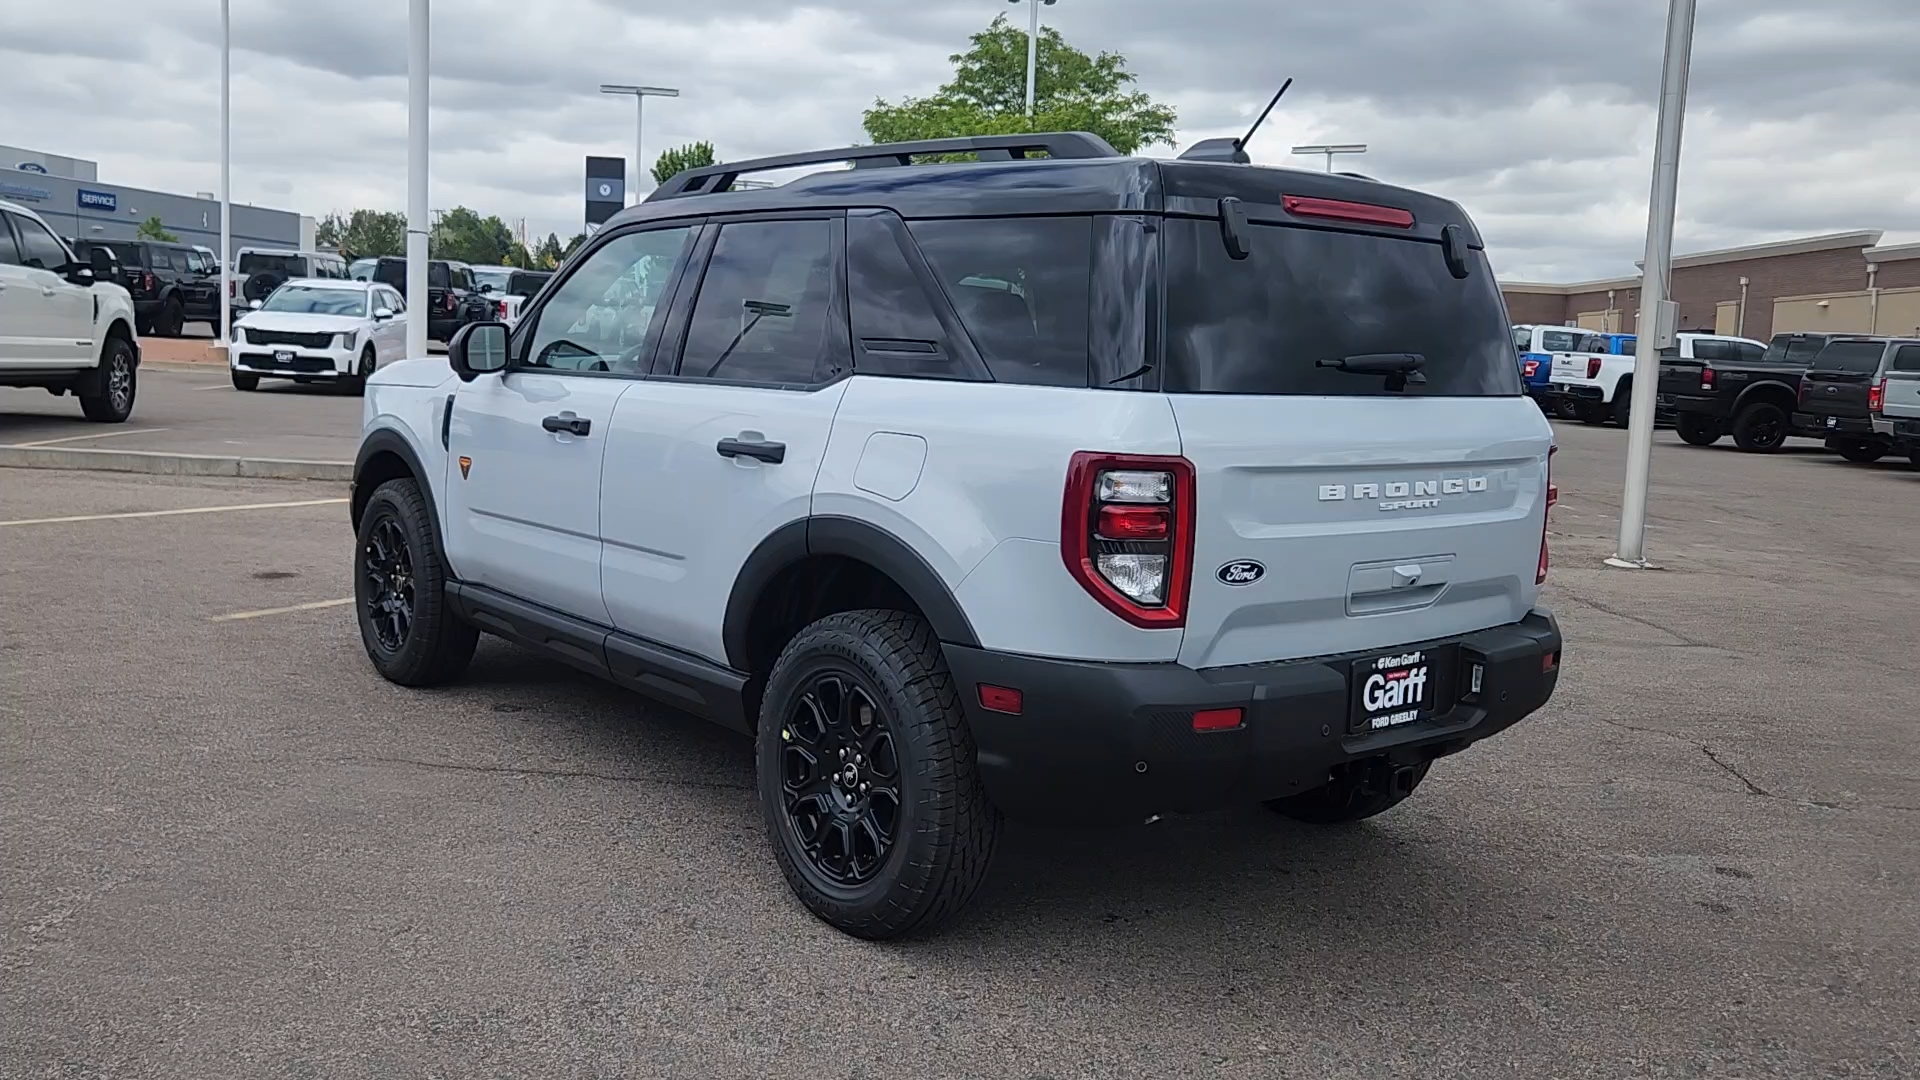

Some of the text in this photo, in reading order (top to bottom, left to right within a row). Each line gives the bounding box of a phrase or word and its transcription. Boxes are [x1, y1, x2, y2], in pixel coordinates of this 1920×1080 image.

[82, 194, 115, 206] SERVICE
[1318, 477, 1488, 501] BRONCO
[1379, 499, 1441, 511] SPORT
[1226, 564, 1259, 581] Ford
[1385, 651, 1421, 668] Ken Garff
[1363, 666, 1428, 711] Garff
[1372, 709, 1418, 729] FORD GREELEY
